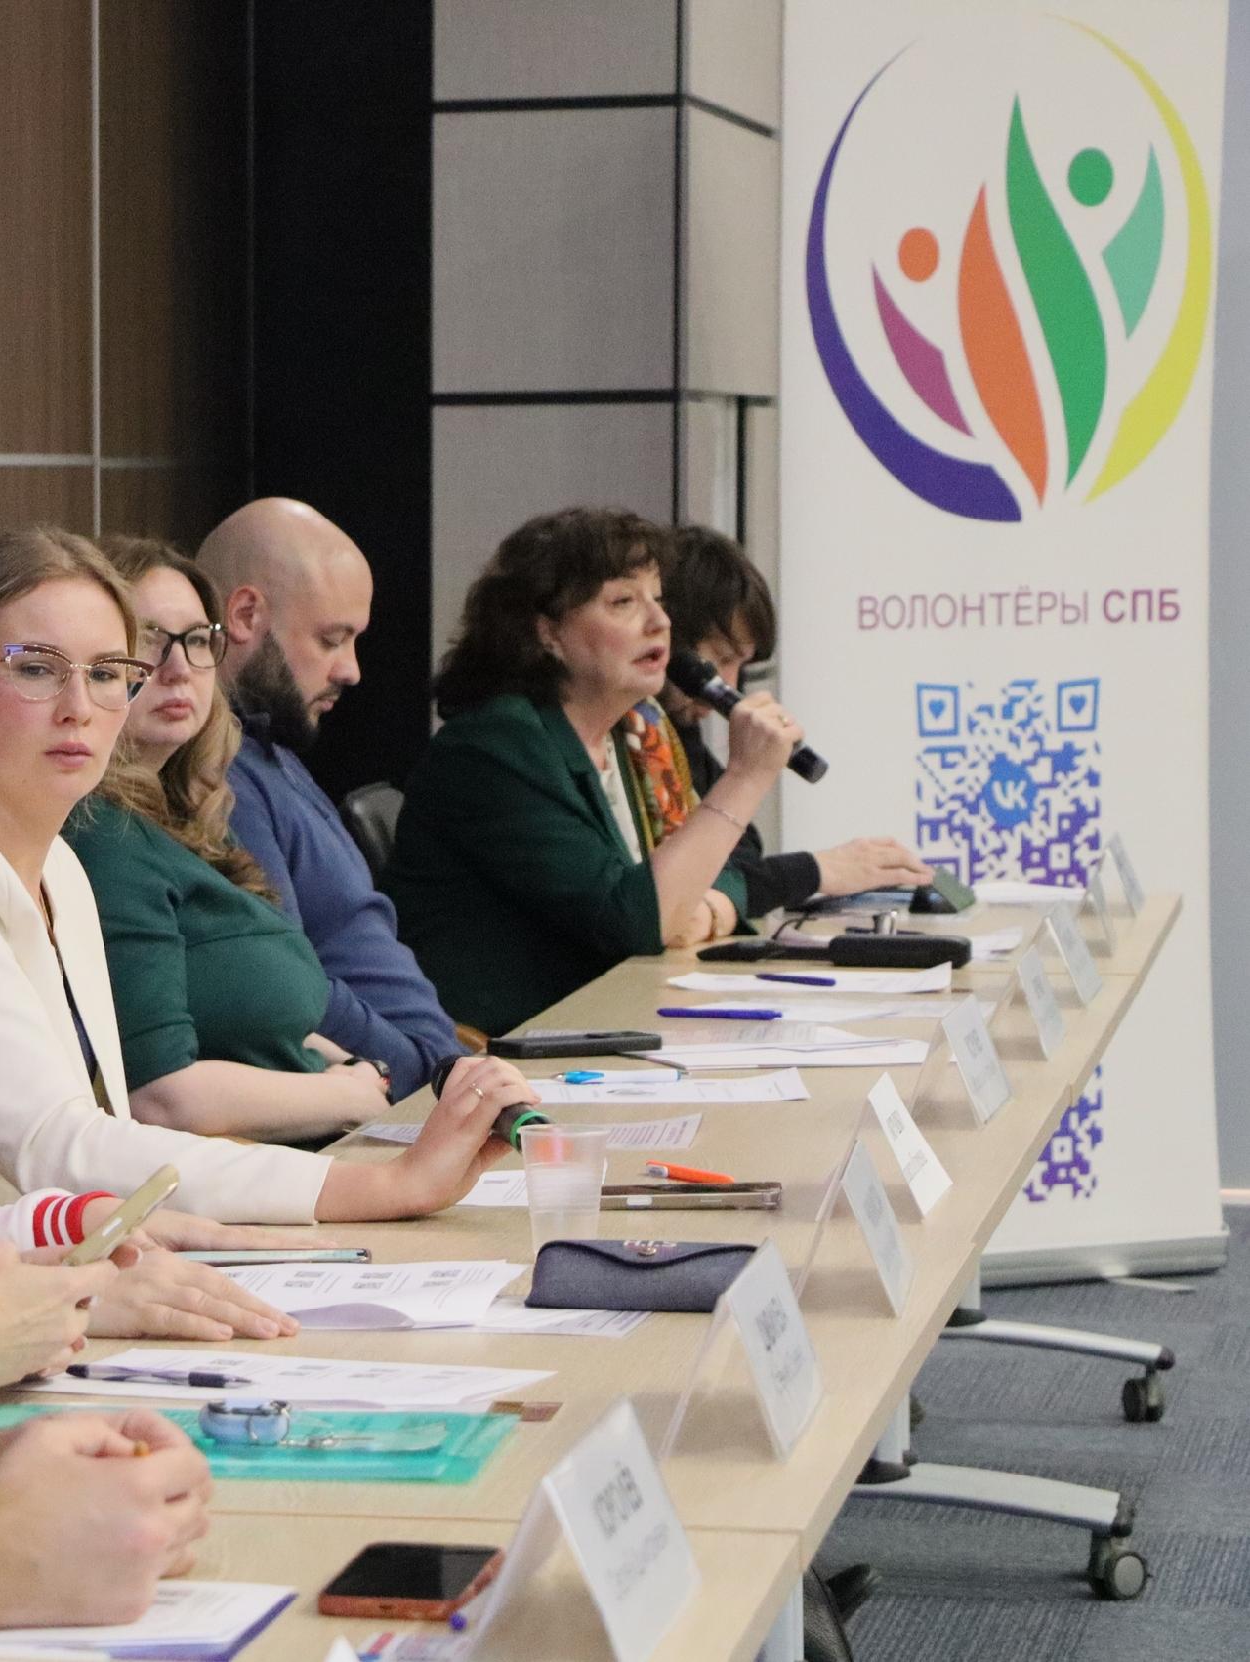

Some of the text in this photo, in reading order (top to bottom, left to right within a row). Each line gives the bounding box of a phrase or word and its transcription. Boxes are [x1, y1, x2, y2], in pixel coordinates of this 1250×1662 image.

[857, 585, 1182, 630] ВОЛОНТЁРЫ СПБ
[993, 780, 1027, 809] VK
